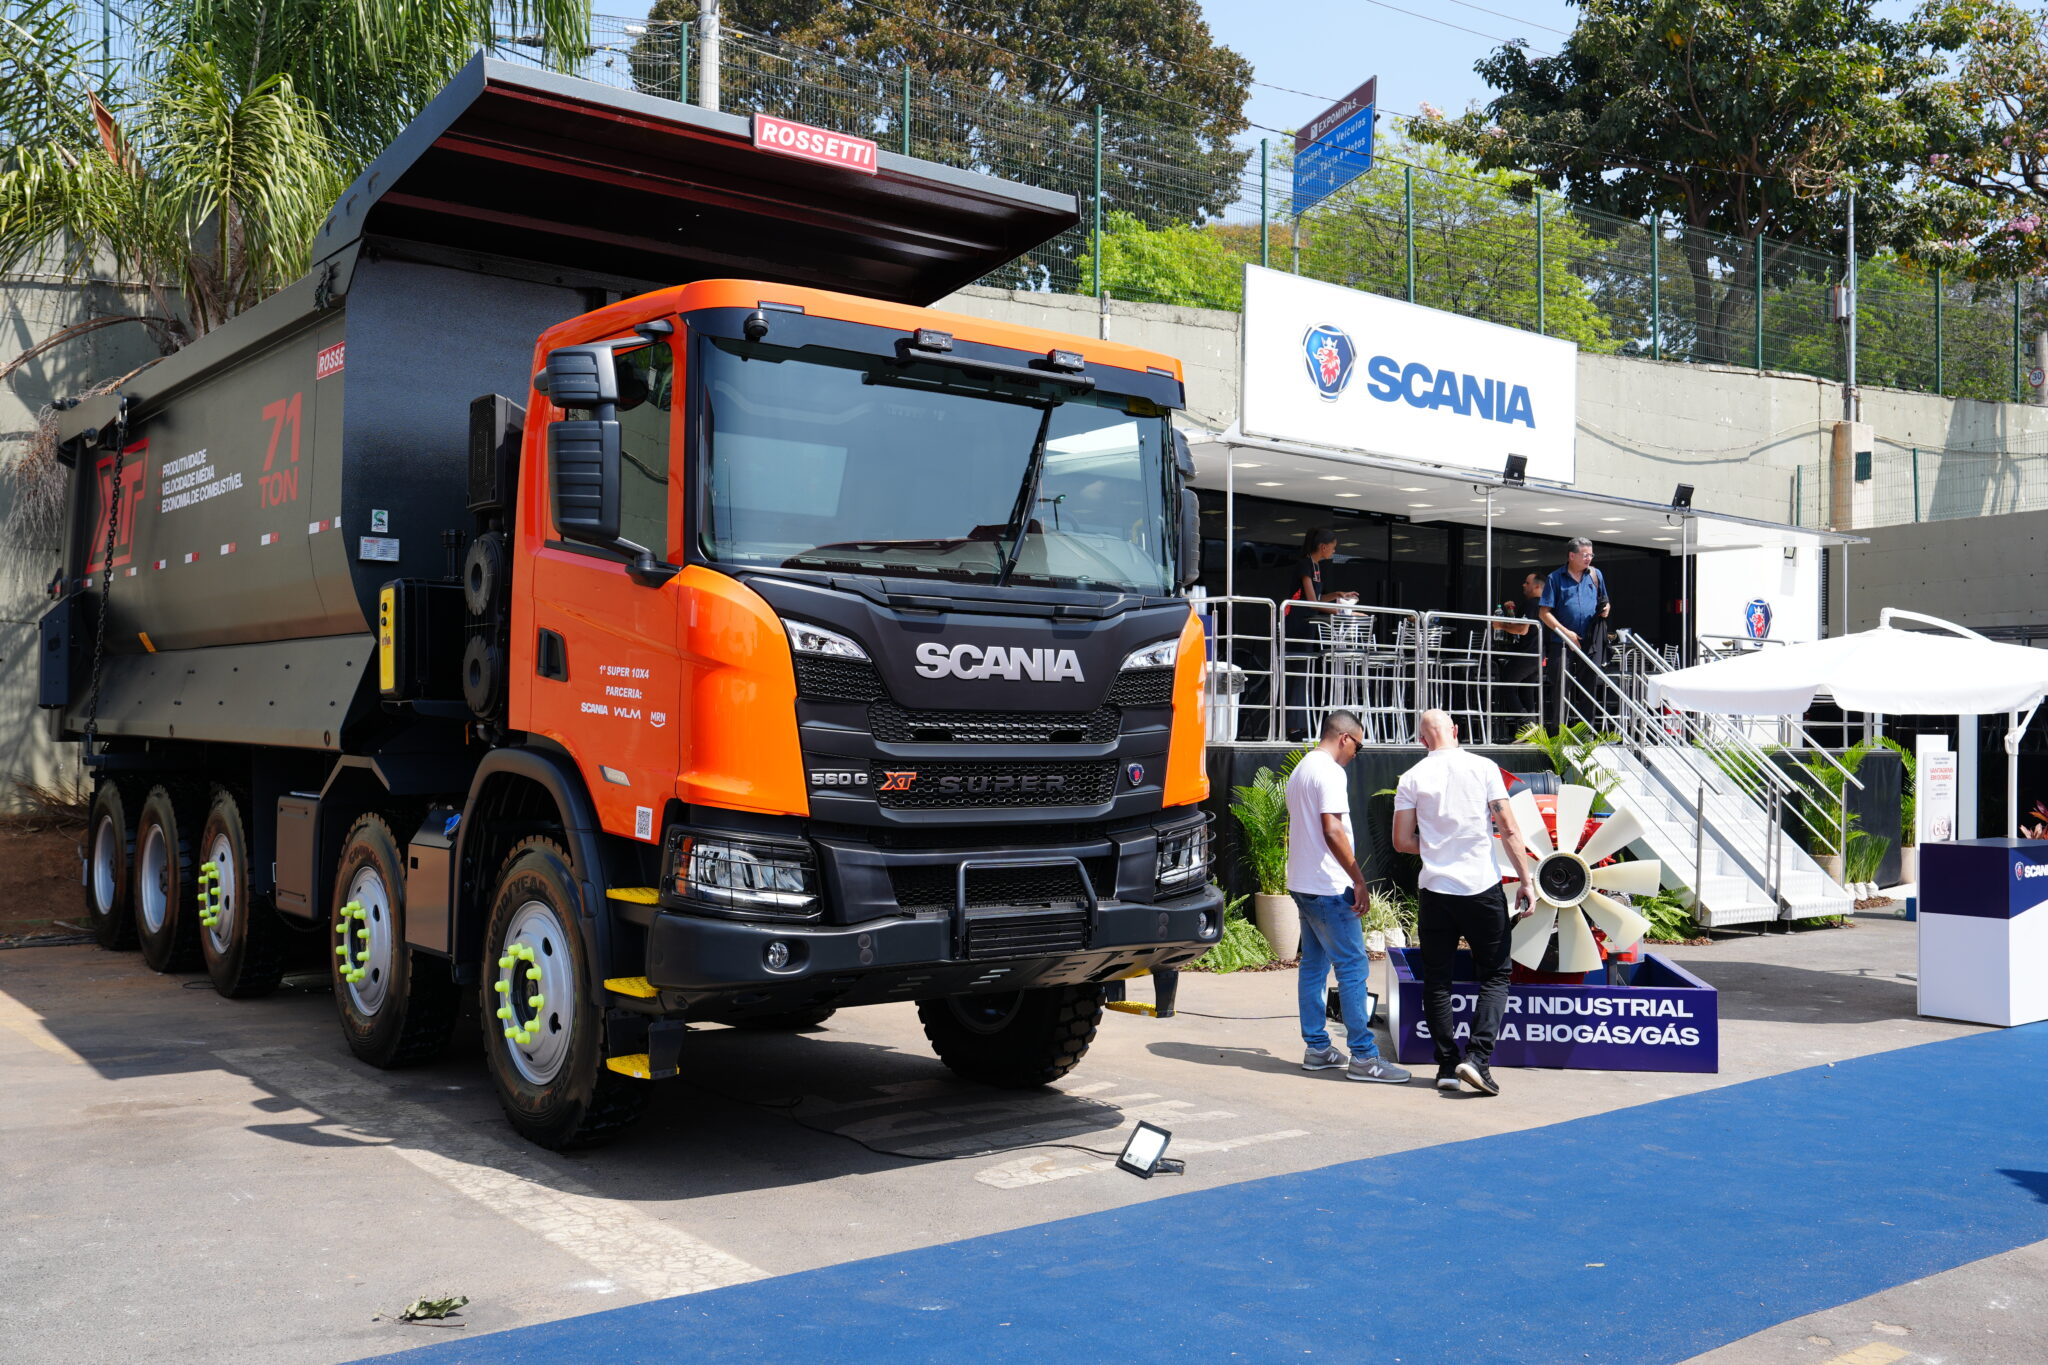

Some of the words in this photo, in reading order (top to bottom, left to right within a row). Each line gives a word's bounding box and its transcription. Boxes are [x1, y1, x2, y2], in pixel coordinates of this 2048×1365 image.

[1319, 98, 1357, 132] EXPOMINAS
[762, 122, 871, 164] ROSSETTI
[1325, 140, 1333, 151] de
[1336, 117, 1366, 143] Veículos
[1340, 151, 1344, 159] e
[1345, 137, 1366, 156] Motos
[2032, 371, 2042, 381] 30
[1367, 355, 1536, 429] SCANIA
[262, 392, 302, 472] 71
[162, 448, 207, 478] PRODUTIVIDADE
[161, 491, 190, 513] ECONOMIA
[191, 489, 200, 504] DE
[200, 472, 243, 501] COMBUSTÍVEL
[162, 472, 196, 496] VELOCIDADE
[196, 465, 215, 485] MÉDIA
[259, 467, 299, 509] TON
[607, 665, 630, 677] SUPER
[631, 668, 649, 679] 10X4
[915, 642, 1086, 683] SCANIA
[606, 685, 643, 699] PARCERIA:
[581, 702, 608, 715] SCANIA
[614, 706, 641, 720] WLM
[650, 711, 666, 722] MRN
[811, 773, 851, 785] 560
[854, 773, 868, 785] G
[880, 772, 917, 791] XT
[939, 775, 1066, 795] SUPER
[1422, 994, 1522, 1014] OTR
[1528, 996, 1694, 1018] INDUSTRIAL
[1416, 1020, 1521, 1041] SAA
[1526, 1021, 1700, 1046] BIOGÁS/GÁS
[1328, 1053, 1338, 1063] N
[1368, 1065, 1383, 1077] N
